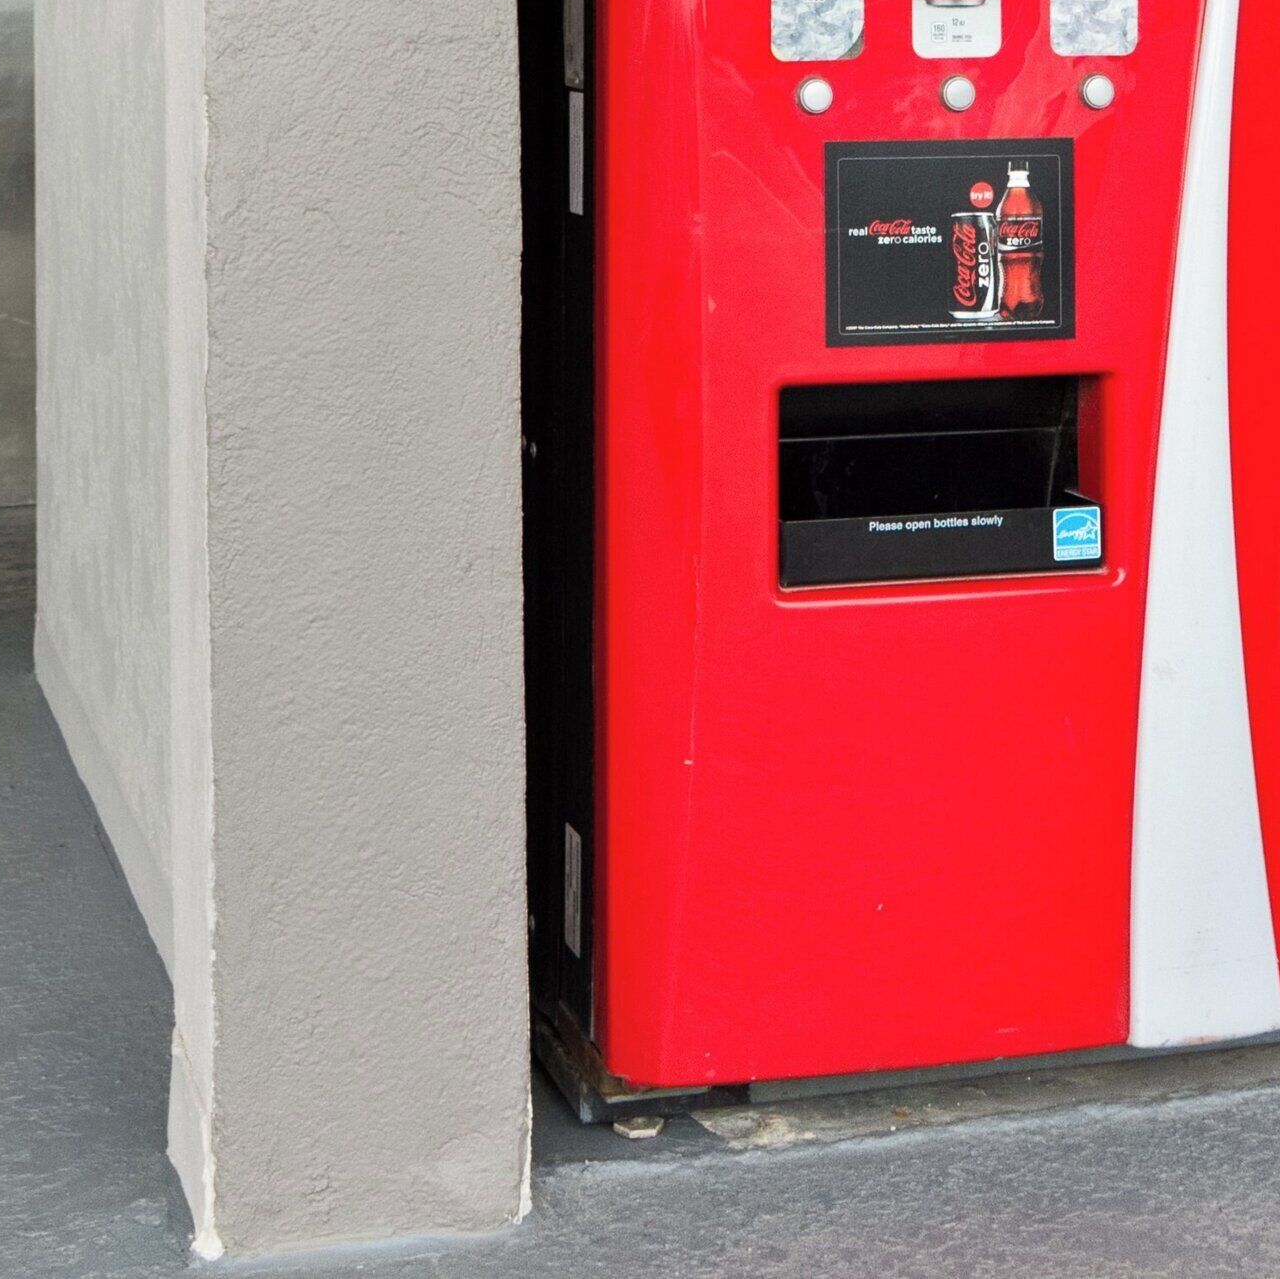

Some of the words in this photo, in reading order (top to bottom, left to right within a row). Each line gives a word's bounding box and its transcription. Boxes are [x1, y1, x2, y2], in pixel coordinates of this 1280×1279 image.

[970, 191, 984, 201] try
[848, 226, 868, 236] real
[868, 219, 912, 235] Coca-Cola
[911, 225, 937, 235] taste
[999, 221, 1039, 237] Coca-Cola
[877, 235, 902, 245] zero
[902, 234, 942, 244] calories
[1006, 237, 1031, 246] zero
[952, 222, 977, 307] Coca-Cola
[978, 242, 990, 288] zero
[868, 520, 903, 532] Please
[905, 520, 931, 532] open
[933, 517, 969, 528] bottles
[970, 514, 1004, 527] slowly
